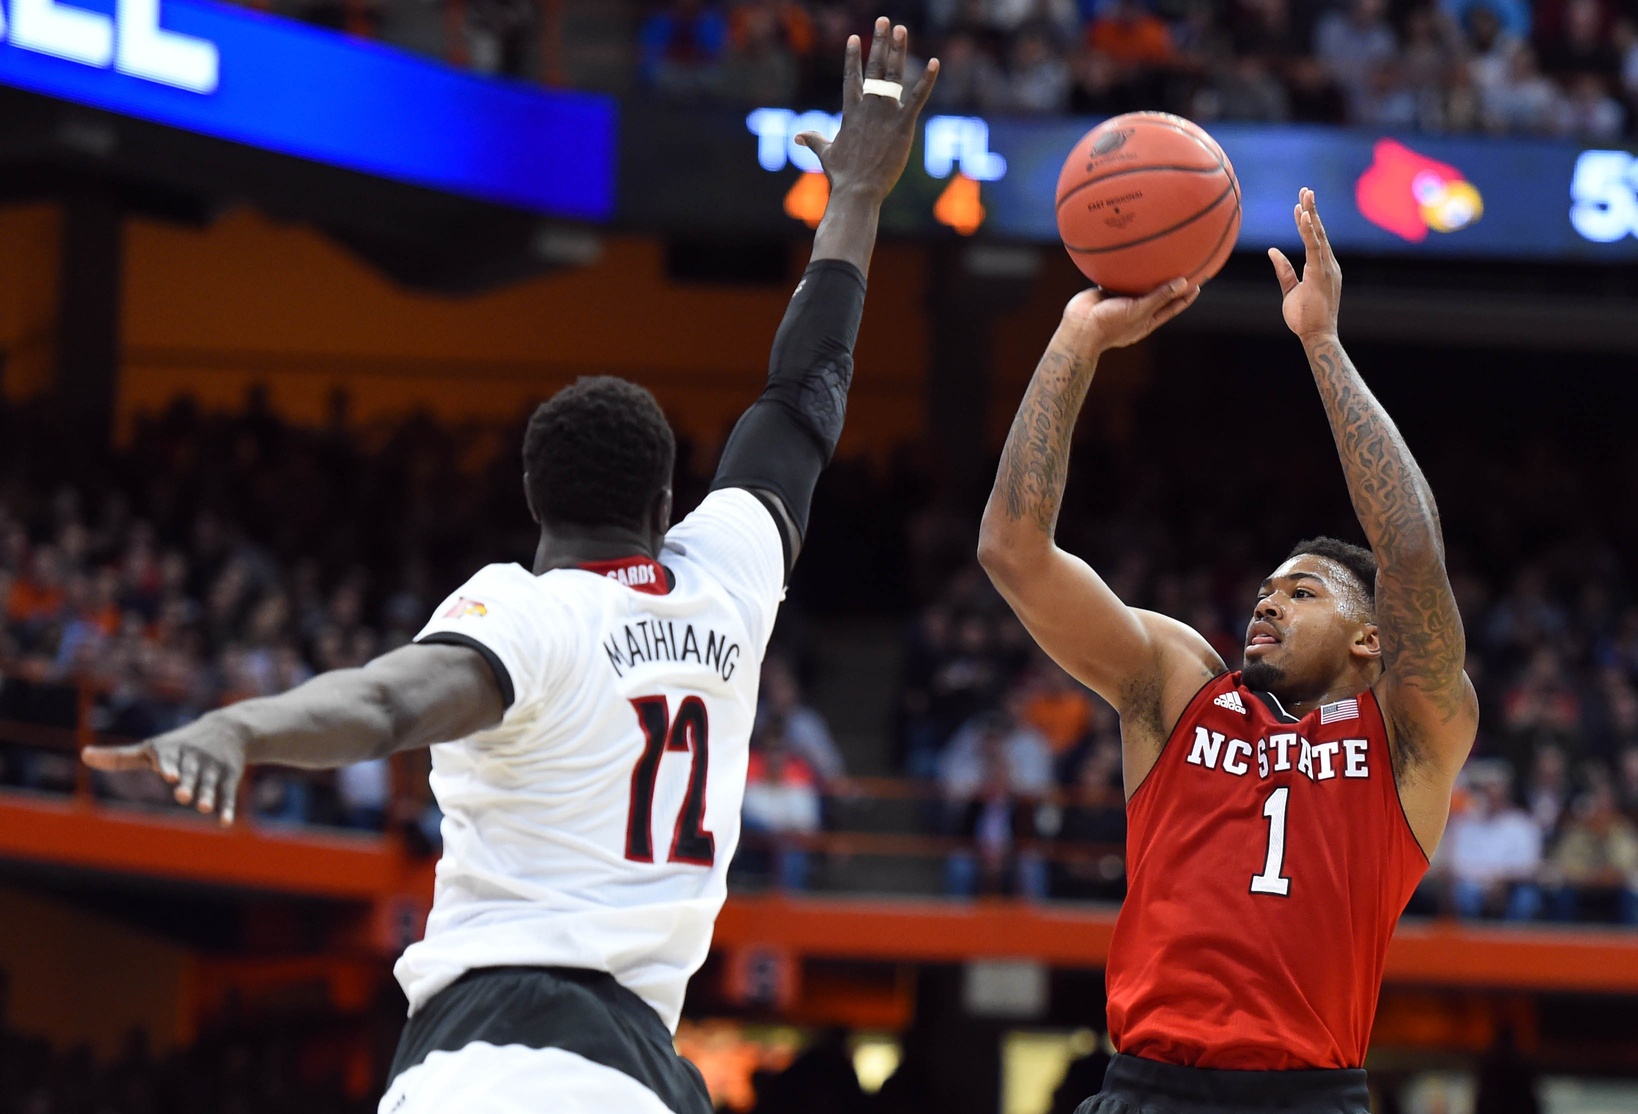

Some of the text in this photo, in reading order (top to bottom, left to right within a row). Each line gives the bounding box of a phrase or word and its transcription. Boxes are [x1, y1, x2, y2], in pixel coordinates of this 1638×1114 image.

[746, 107, 843, 173] TO
[603, 620, 740, 682] MATHIANG
[625, 694, 715, 867] 12
[1186, 726, 1370, 781] NC STATE
[1249, 786, 1290, 896] 1
